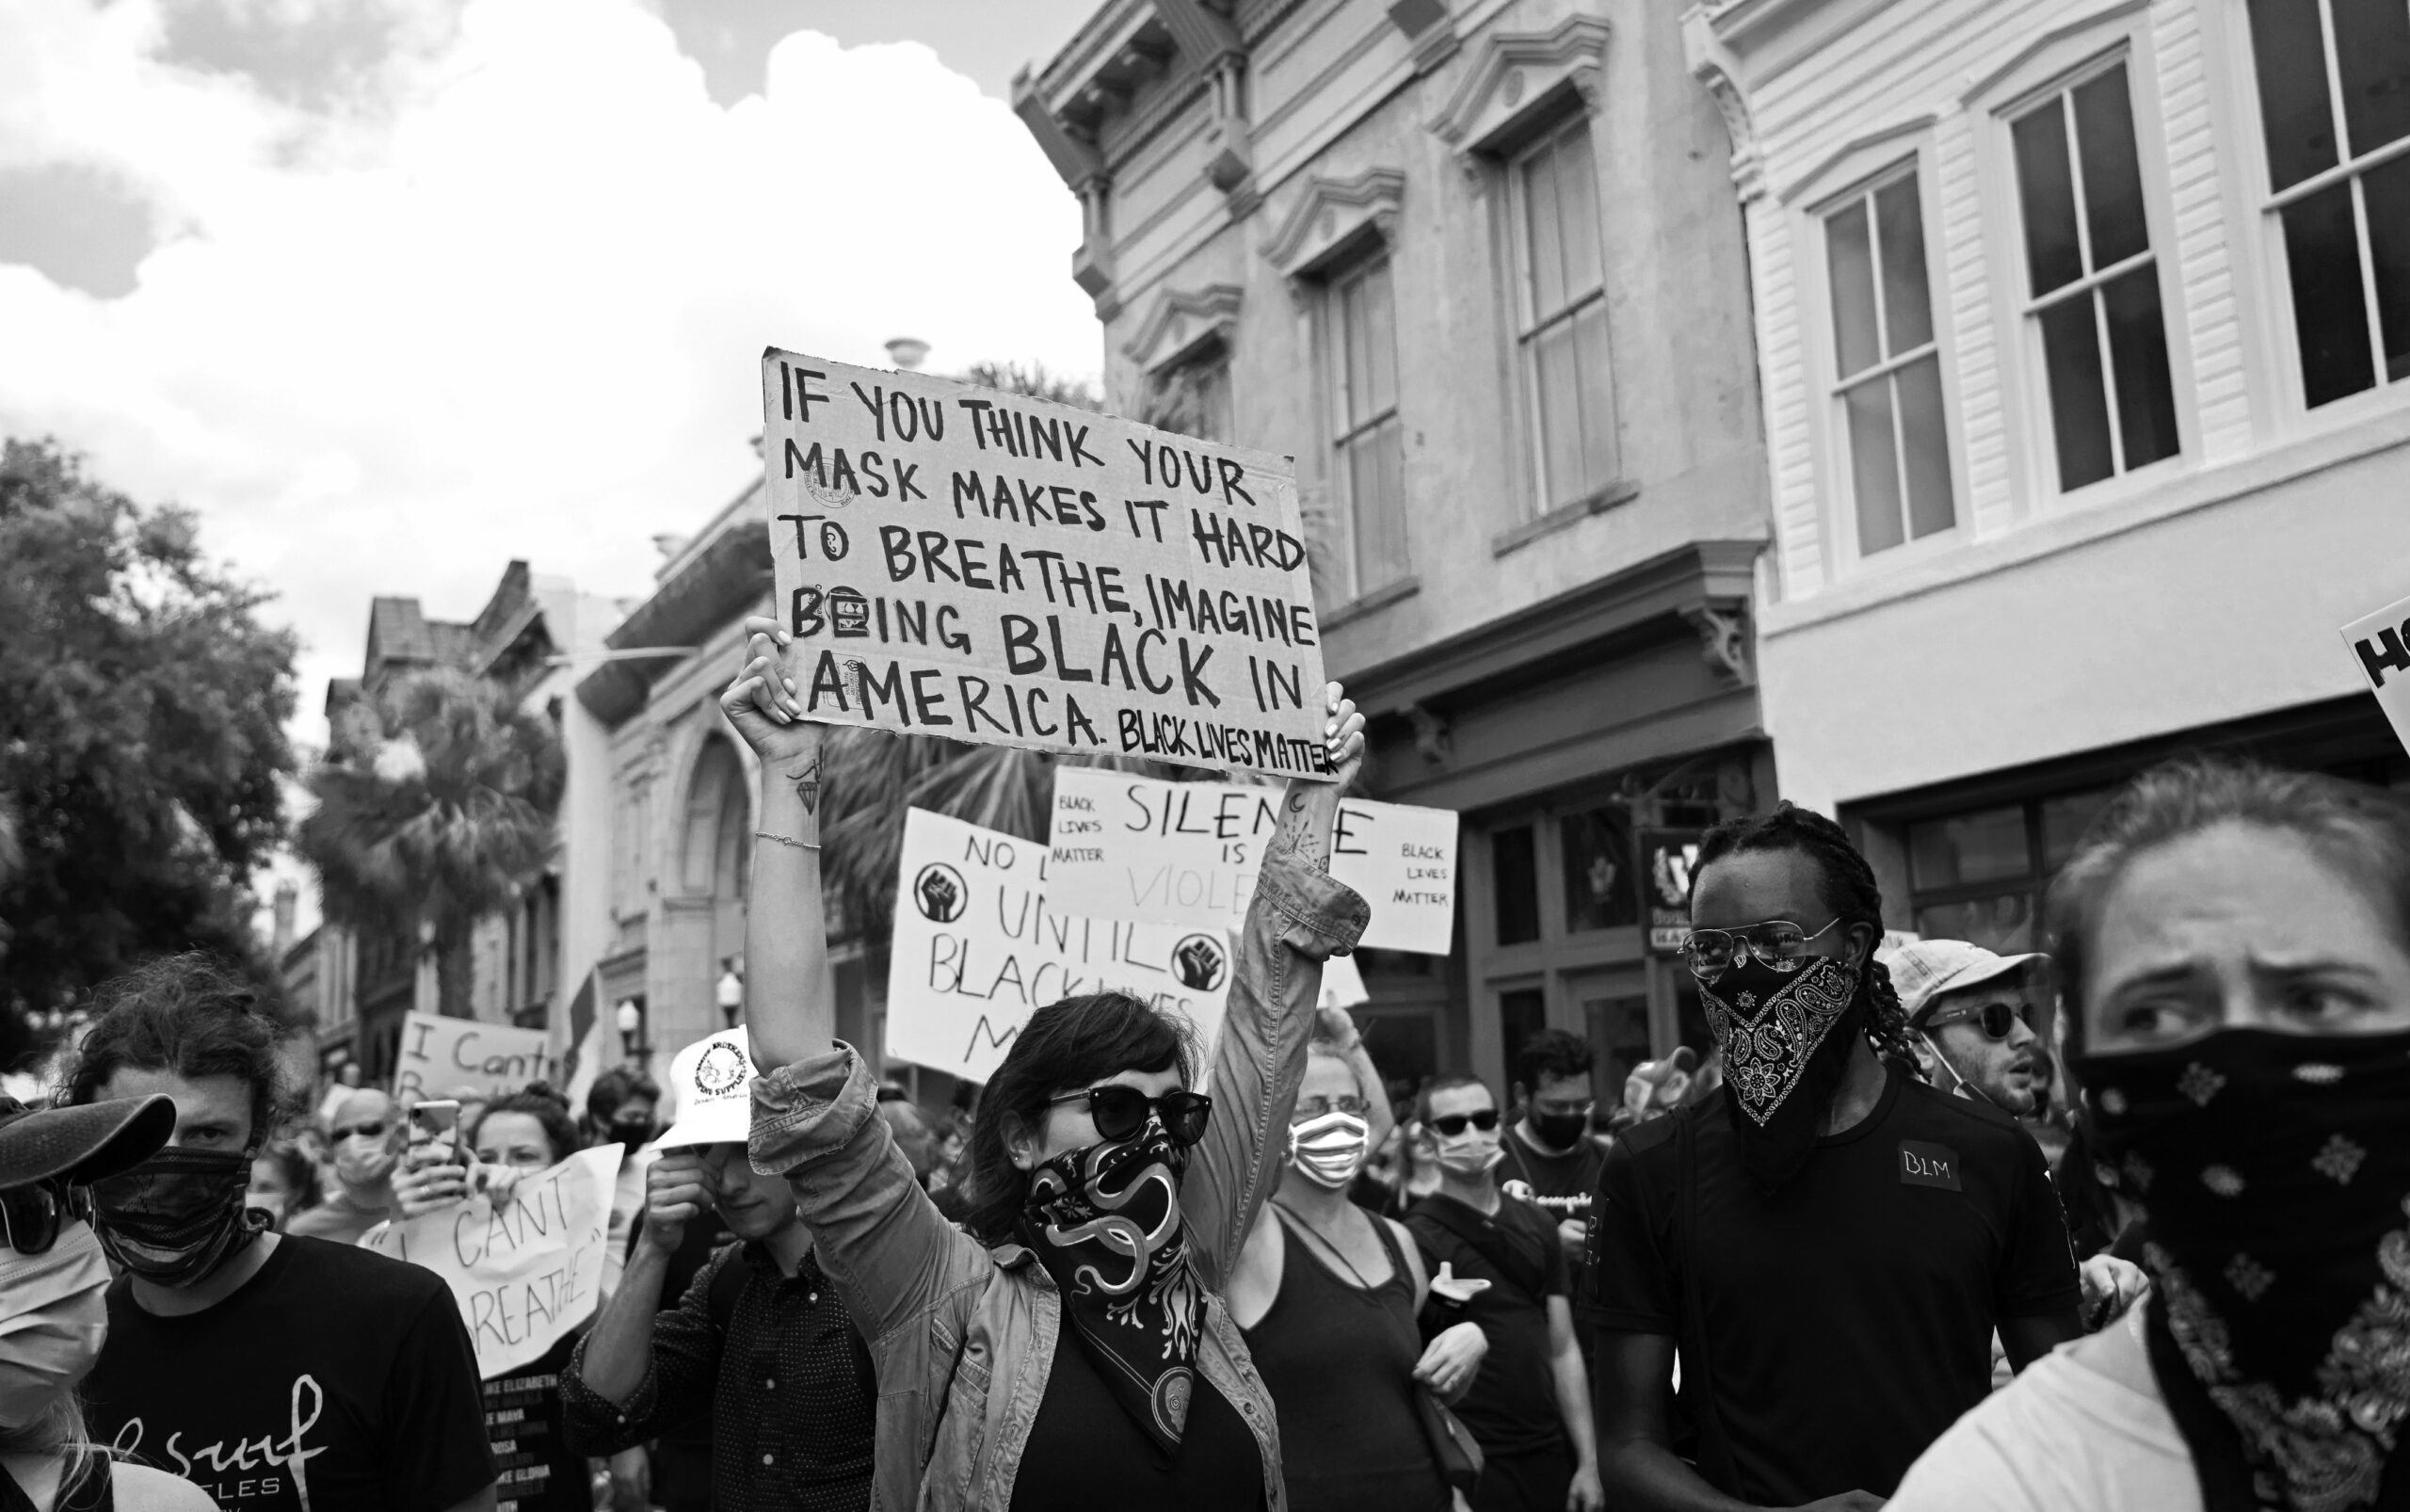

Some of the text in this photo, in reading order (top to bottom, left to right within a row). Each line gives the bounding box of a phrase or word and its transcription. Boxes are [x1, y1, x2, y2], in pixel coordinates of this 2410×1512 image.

[779, 362, 1256, 507] IF YOU THINK YOUR
[784, 438, 927, 501] MASK
[953, 470, 1105, 531] MAKES
[1125, 500, 1169, 542] IT
[1192, 507, 1306, 571] HARD
[778, 514, 849, 561] TO
[1146, 573, 1316, 647] IMAGINE
[792, 586, 972, 654] BEING
[1001, 614, 1221, 709] BLACK
[1249, 655, 1303, 712] IN
[807, 649, 1107, 747] AMERICA.
[1117, 708, 1196, 756] BLACK
[1195, 720, 1253, 766] LIVES
[1059, 796, 1096, 812] BLACK
[1125, 784, 1375, 855] SILENE
[1059, 820, 1103, 834] LIVES
[964, 835, 1015, 870] NO
[1052, 847, 1104, 862] MATTER
[1223, 844, 1245, 864] IS
[1402, 843, 1444, 861] BLACK
[1406, 867, 1448, 879] LIVES
[1128, 863, 1259, 914] VIOLE
[1392, 889, 1449, 907] MATTER
[407, 1021, 436, 1061] I
[1904, 1150, 1951, 1179] BLM
[455, 1167, 570, 1268] CANT
[468, 1227, 602, 1356] REATHE"
